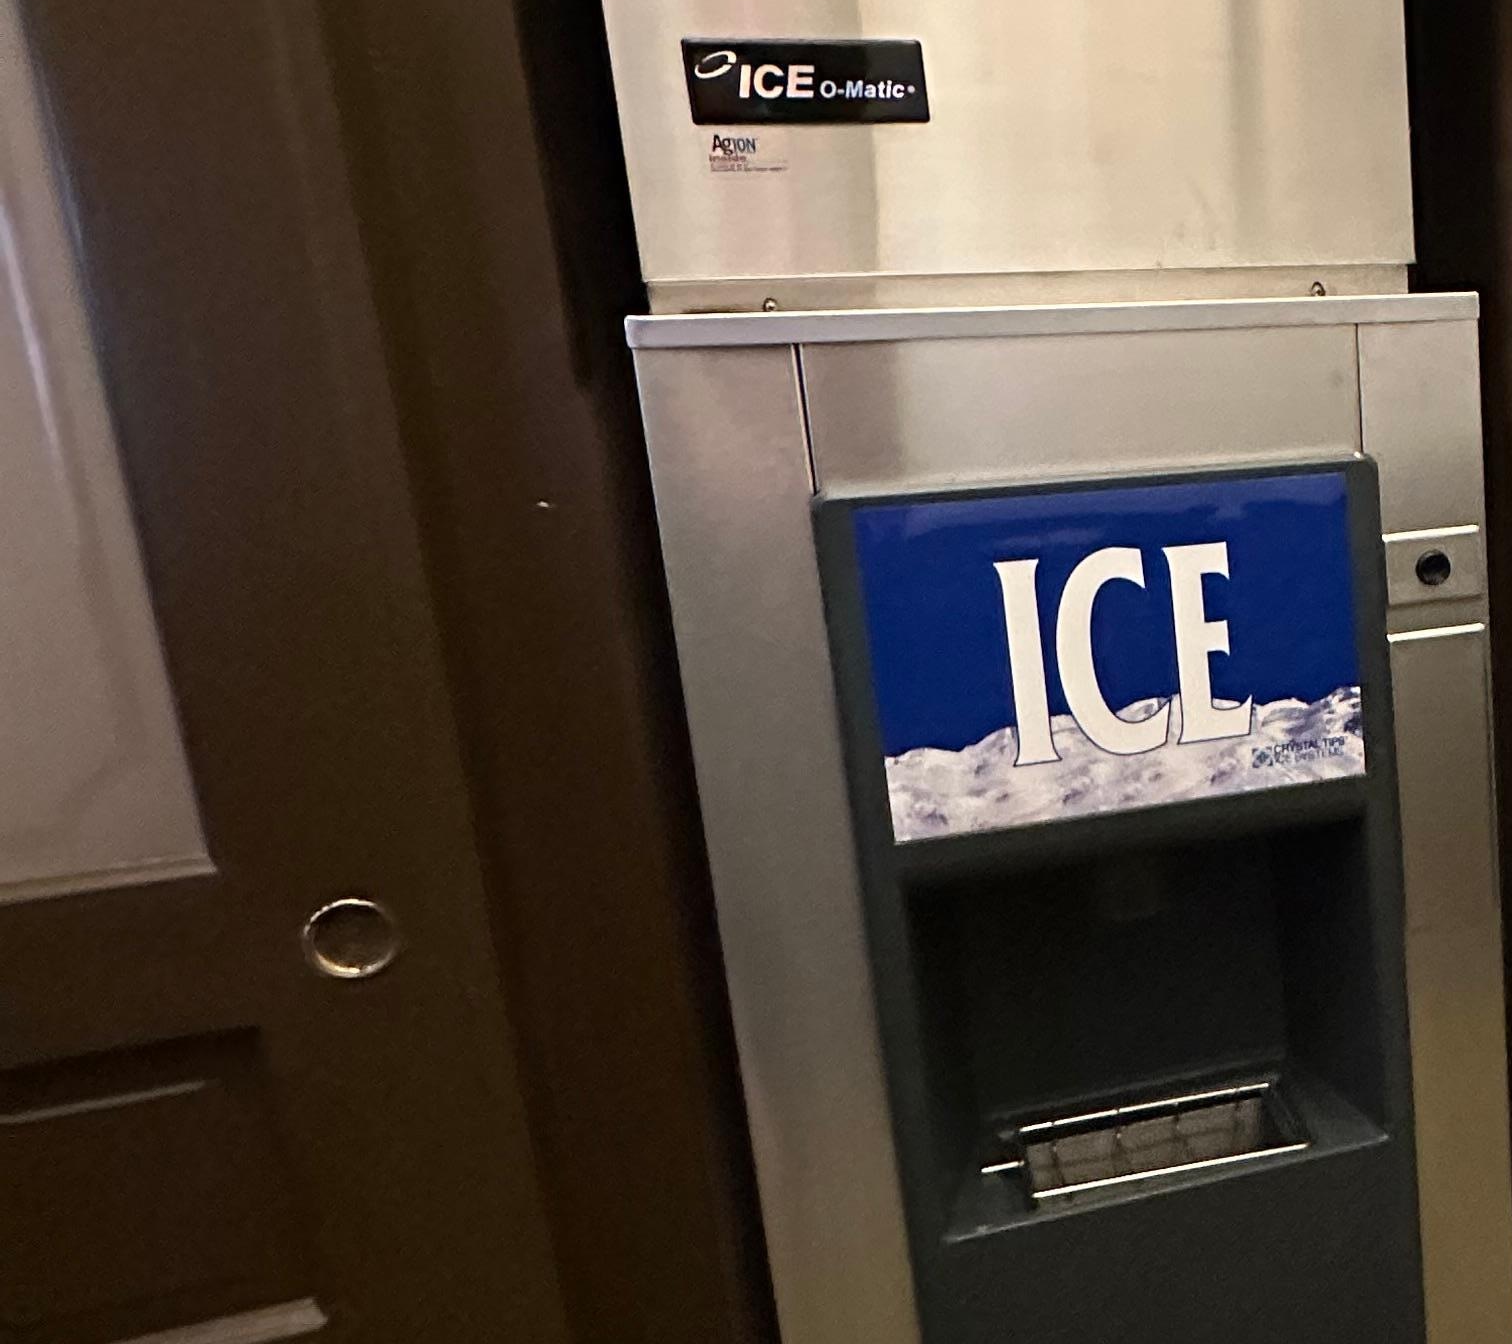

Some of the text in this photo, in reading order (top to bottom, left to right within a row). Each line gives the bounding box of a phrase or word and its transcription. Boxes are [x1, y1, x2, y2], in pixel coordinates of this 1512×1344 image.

[738, 64, 905, 99] ICE O-Matic
[992, 541, 1253, 768] ICE
